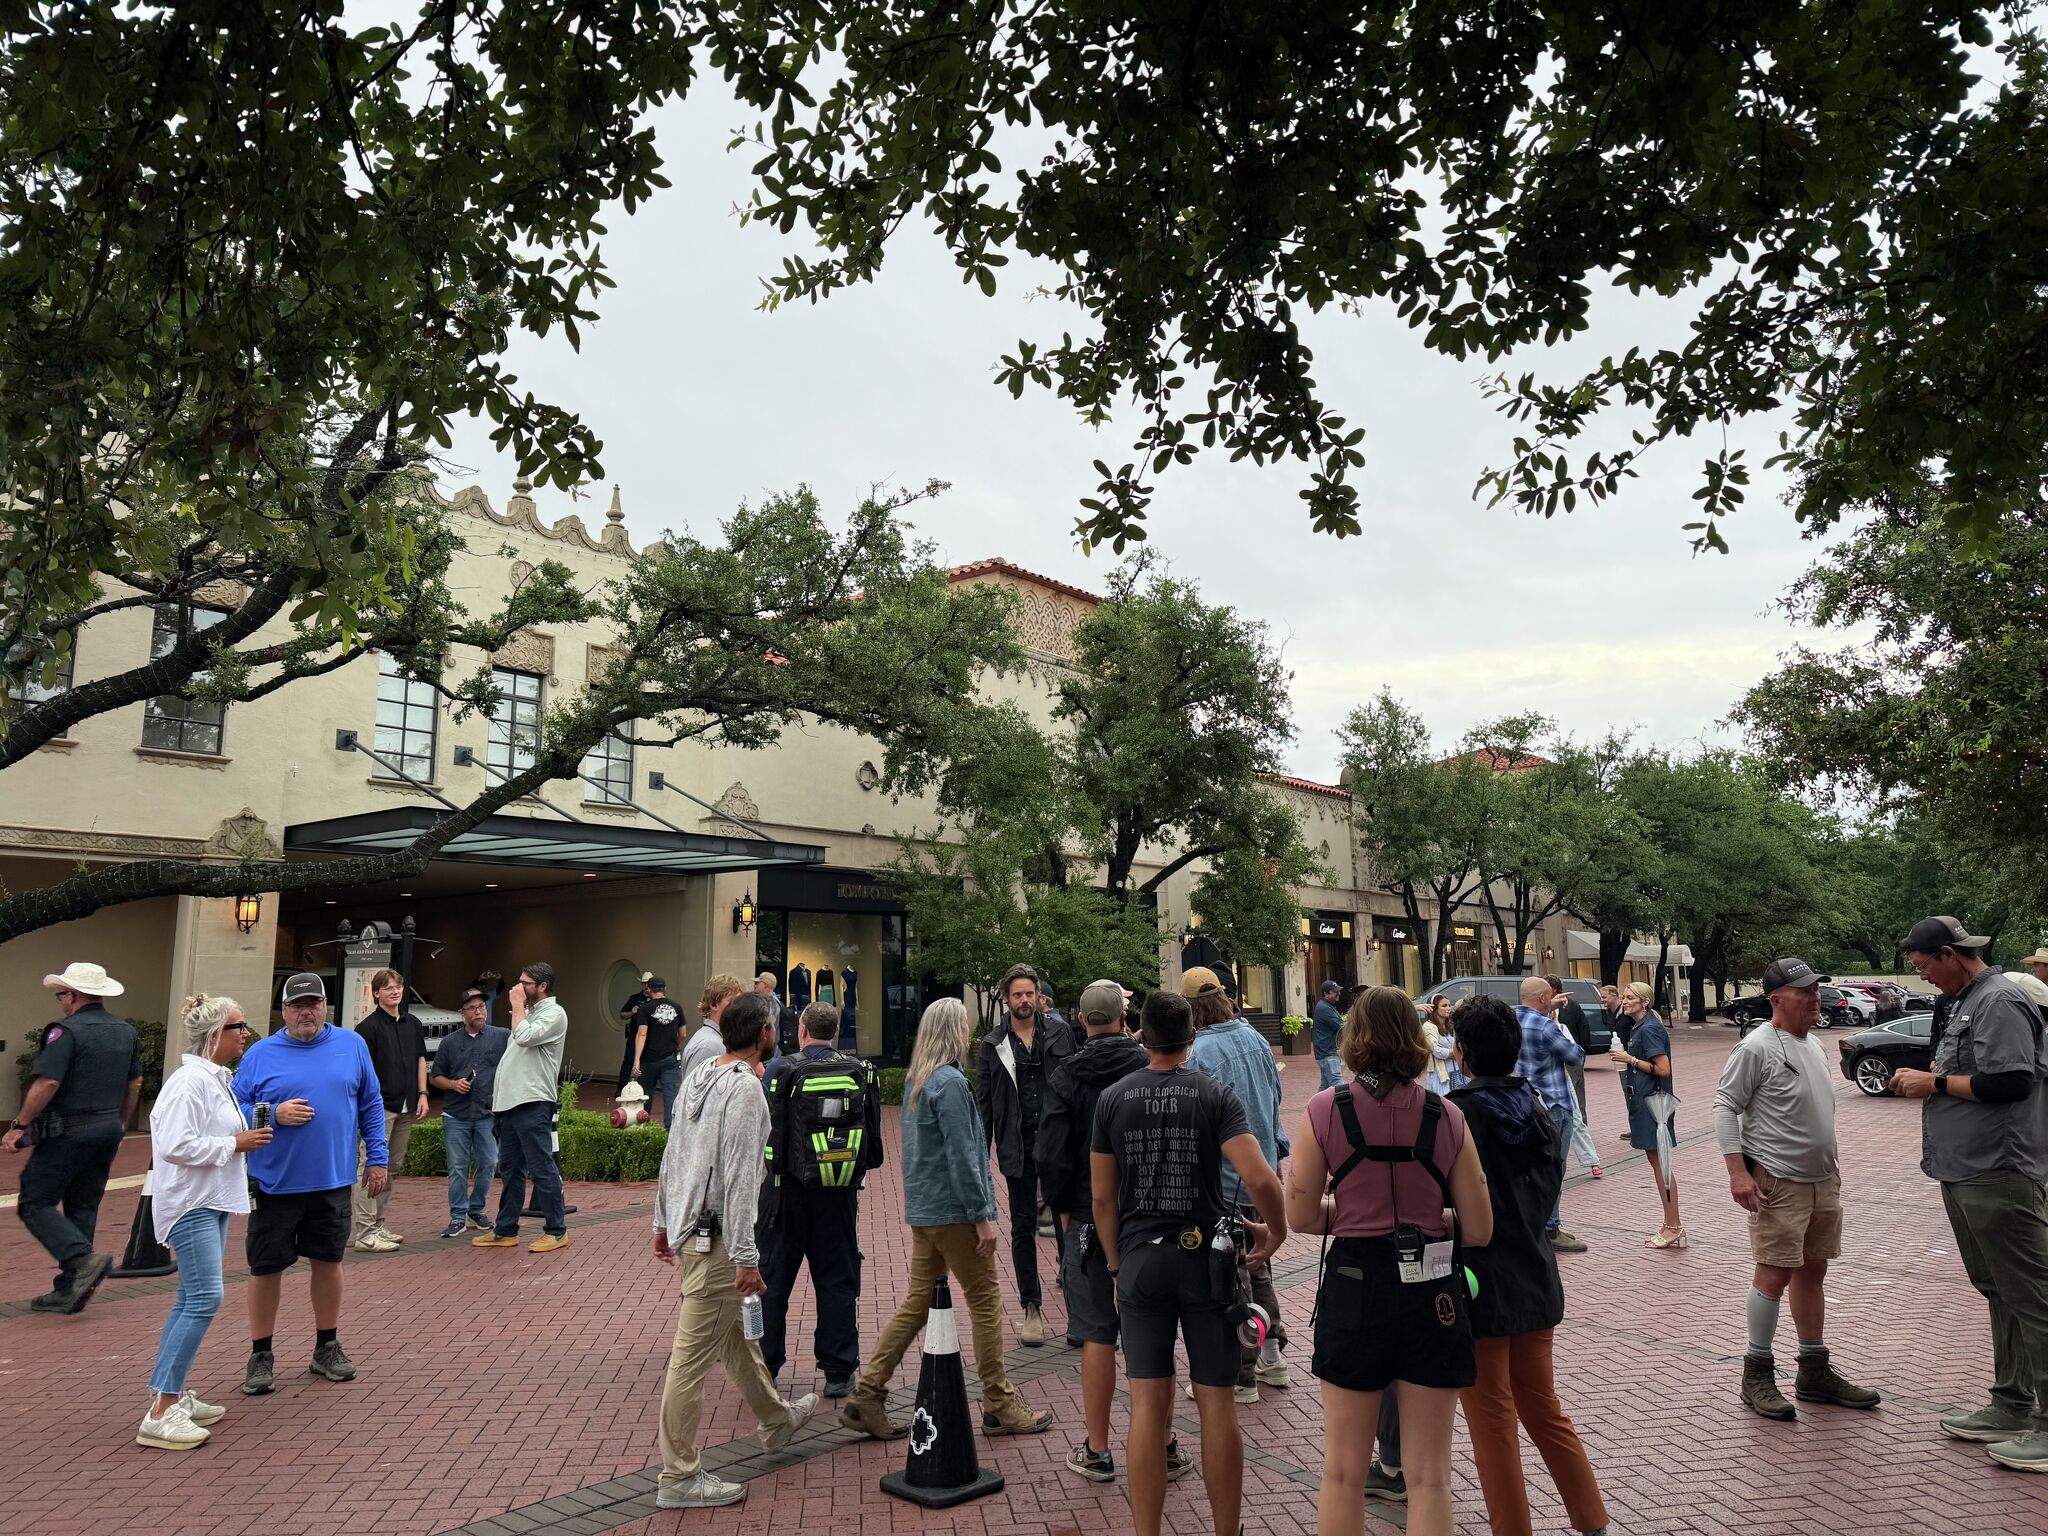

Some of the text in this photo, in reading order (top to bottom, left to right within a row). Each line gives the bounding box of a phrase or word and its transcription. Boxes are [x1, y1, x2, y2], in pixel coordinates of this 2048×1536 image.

[1319, 922, 1336, 934] Cartier
[1392, 928, 1407, 939] Cartier
[1124, 1087, 1151, 1101] NORTH
[1143, 1097, 1178, 1115] TOUR
[1123, 1130, 1144, 1141] 1990
[1146, 1128, 1162, 1139] LOS
[1166, 1151, 1199, 1164] ORLEAN
[1157, 1162, 1191, 1175] CHICAGO
[1157, 1175, 1192, 1187] ATLANTA
[1137, 1199, 1193, 1211] 017 TORONTO
